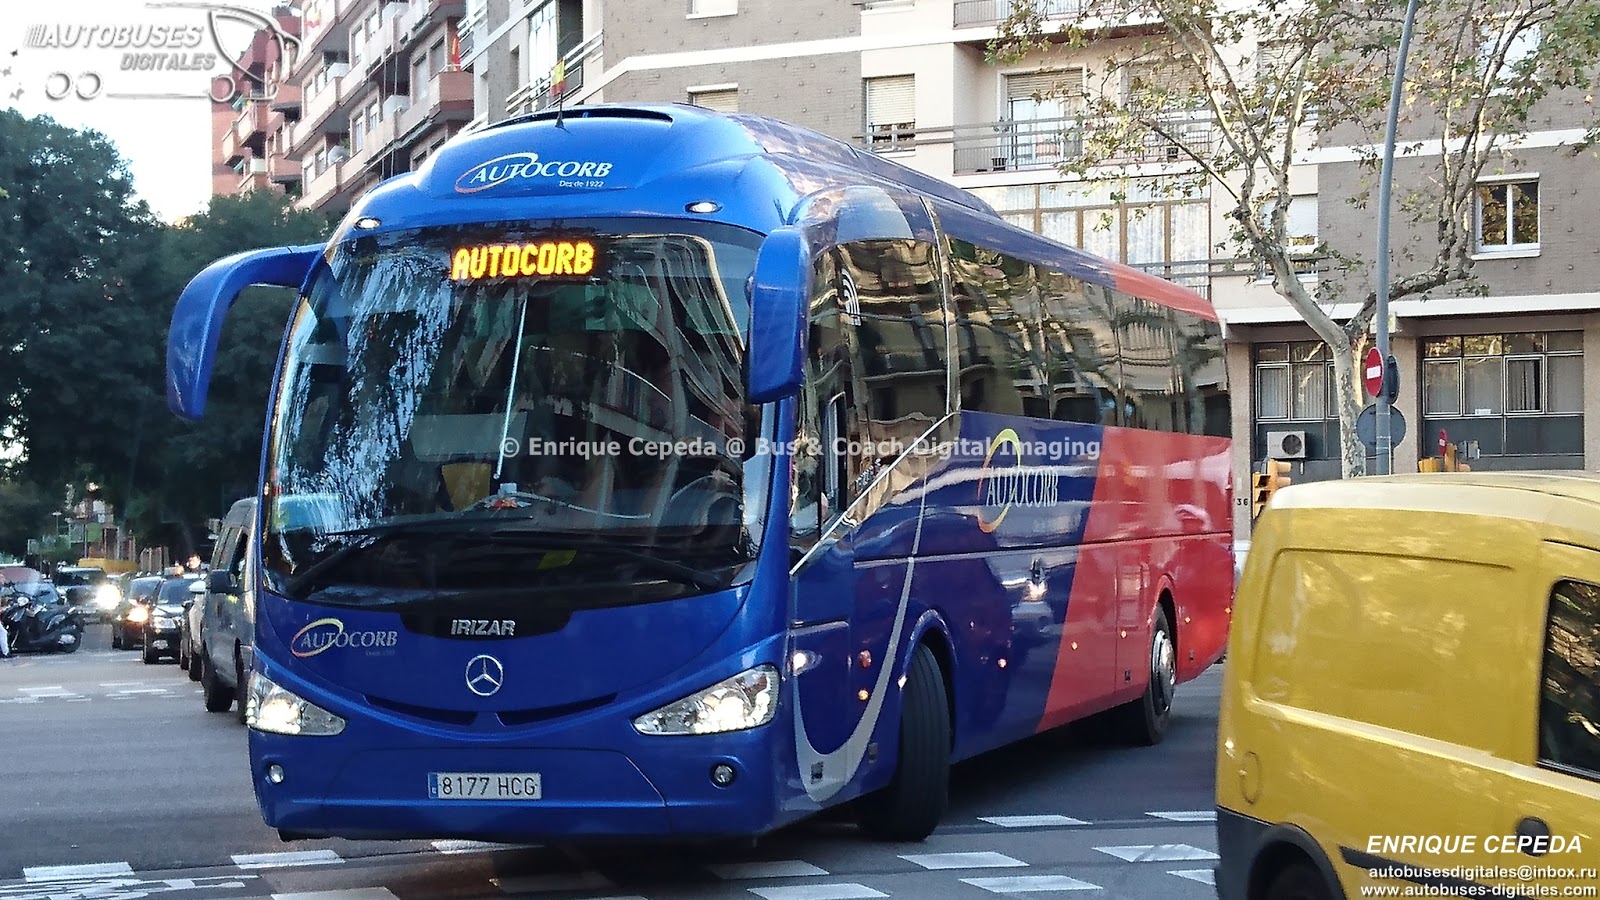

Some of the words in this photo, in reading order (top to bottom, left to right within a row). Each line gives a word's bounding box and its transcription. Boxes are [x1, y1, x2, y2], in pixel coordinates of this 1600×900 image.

[469, 161, 613, 184] AUTOCORB
[452, 241, 595, 280] AUTOCORB
[986, 467, 1058, 508] AUTOCORB
[451, 620, 516, 636] IRIZAR
[301, 631, 398, 648] AUTOCORB
[442, 777, 490, 795] 8177
[498, 777, 536, 796] HCG
